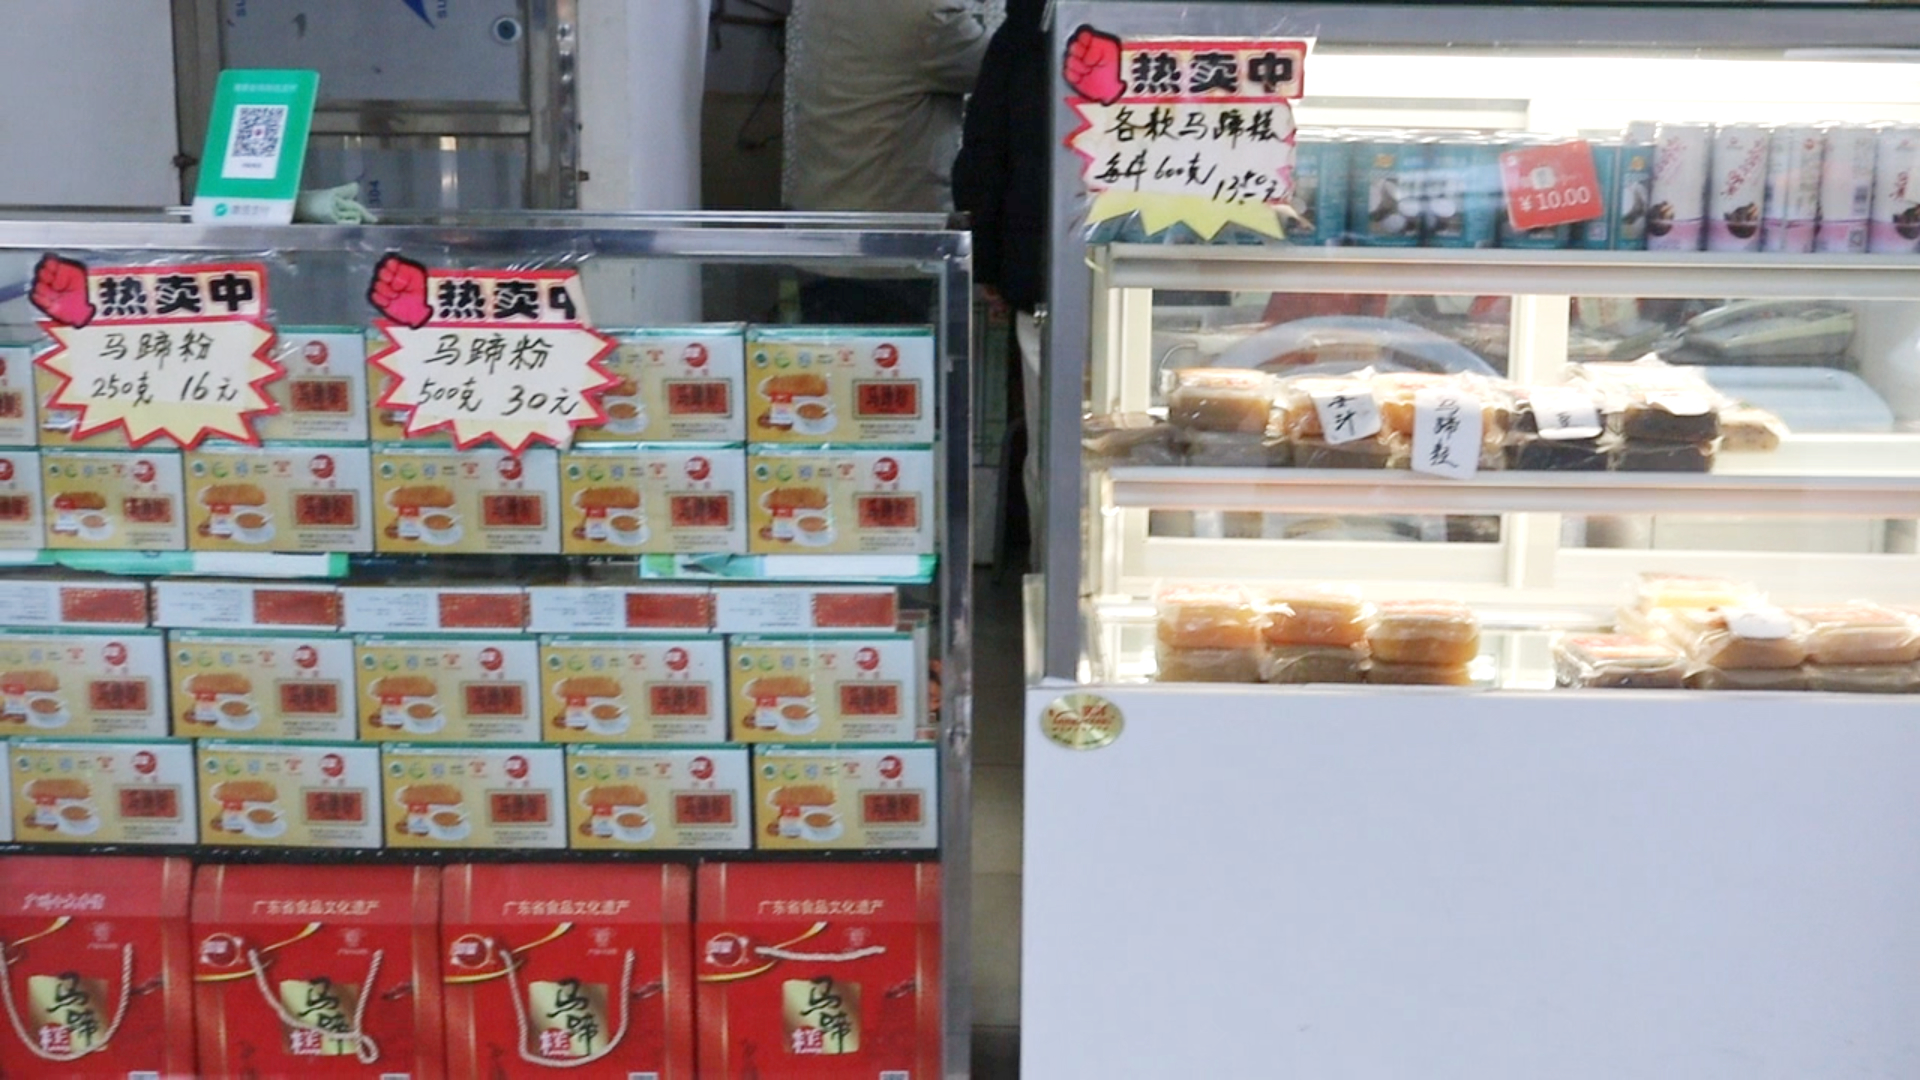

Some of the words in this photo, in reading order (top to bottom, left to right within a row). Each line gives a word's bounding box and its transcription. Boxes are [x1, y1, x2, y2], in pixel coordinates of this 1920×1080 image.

[1132, 52, 1293, 93] 热卖中
[1104, 106, 1284, 149] 各款马蹄糕
[1519, 186, 1591, 212] ¥10.00
[99, 273, 253, 316] 热卖中
[99, 328, 215, 370] 马蹄粉
[423, 332, 554, 375] 马蹄粉
[91, 370, 154, 408] 250克
[179, 371, 238, 402] 16元
[418, 376, 482, 413] 500克
[500, 385, 580, 416] 30元
